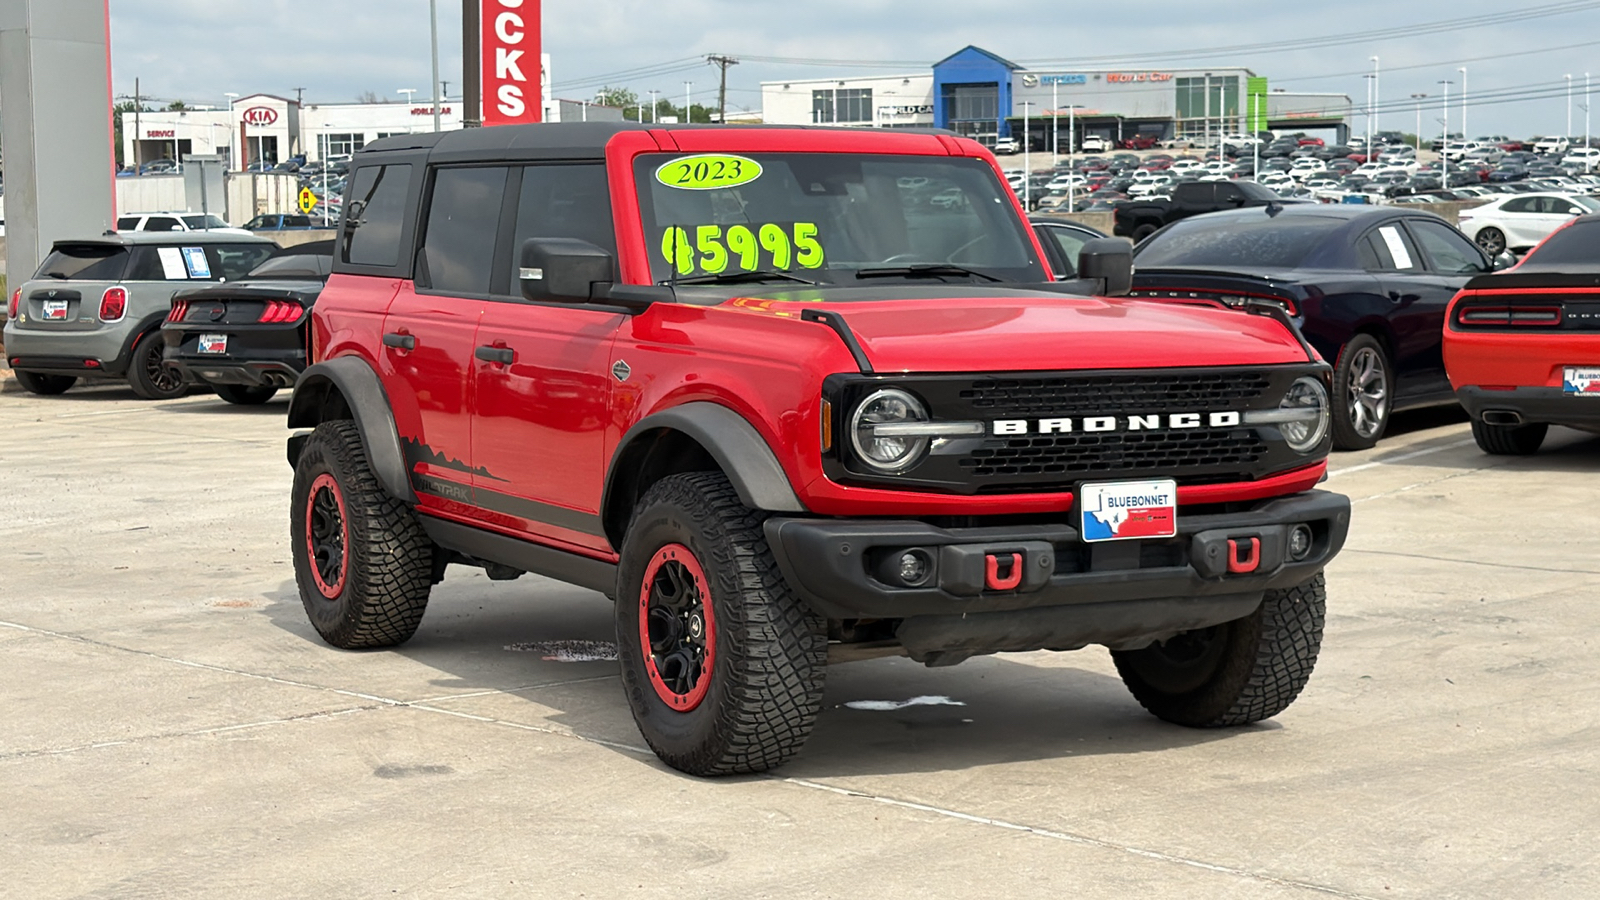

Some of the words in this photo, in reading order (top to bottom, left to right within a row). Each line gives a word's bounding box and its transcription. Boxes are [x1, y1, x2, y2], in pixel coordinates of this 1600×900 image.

[495, 0, 527, 117] CKS
[1107, 72, 1146, 83] World
[1149, 71, 1173, 82] Car
[249, 111, 273, 122] KIA
[147, 130, 175, 138] SERVICE
[677, 160, 742, 184] 2023
[661, 222, 824, 275] 45995
[993, 411, 1240, 435] BRONCO
[1108, 494, 1168, 508] BLUEBONNET
